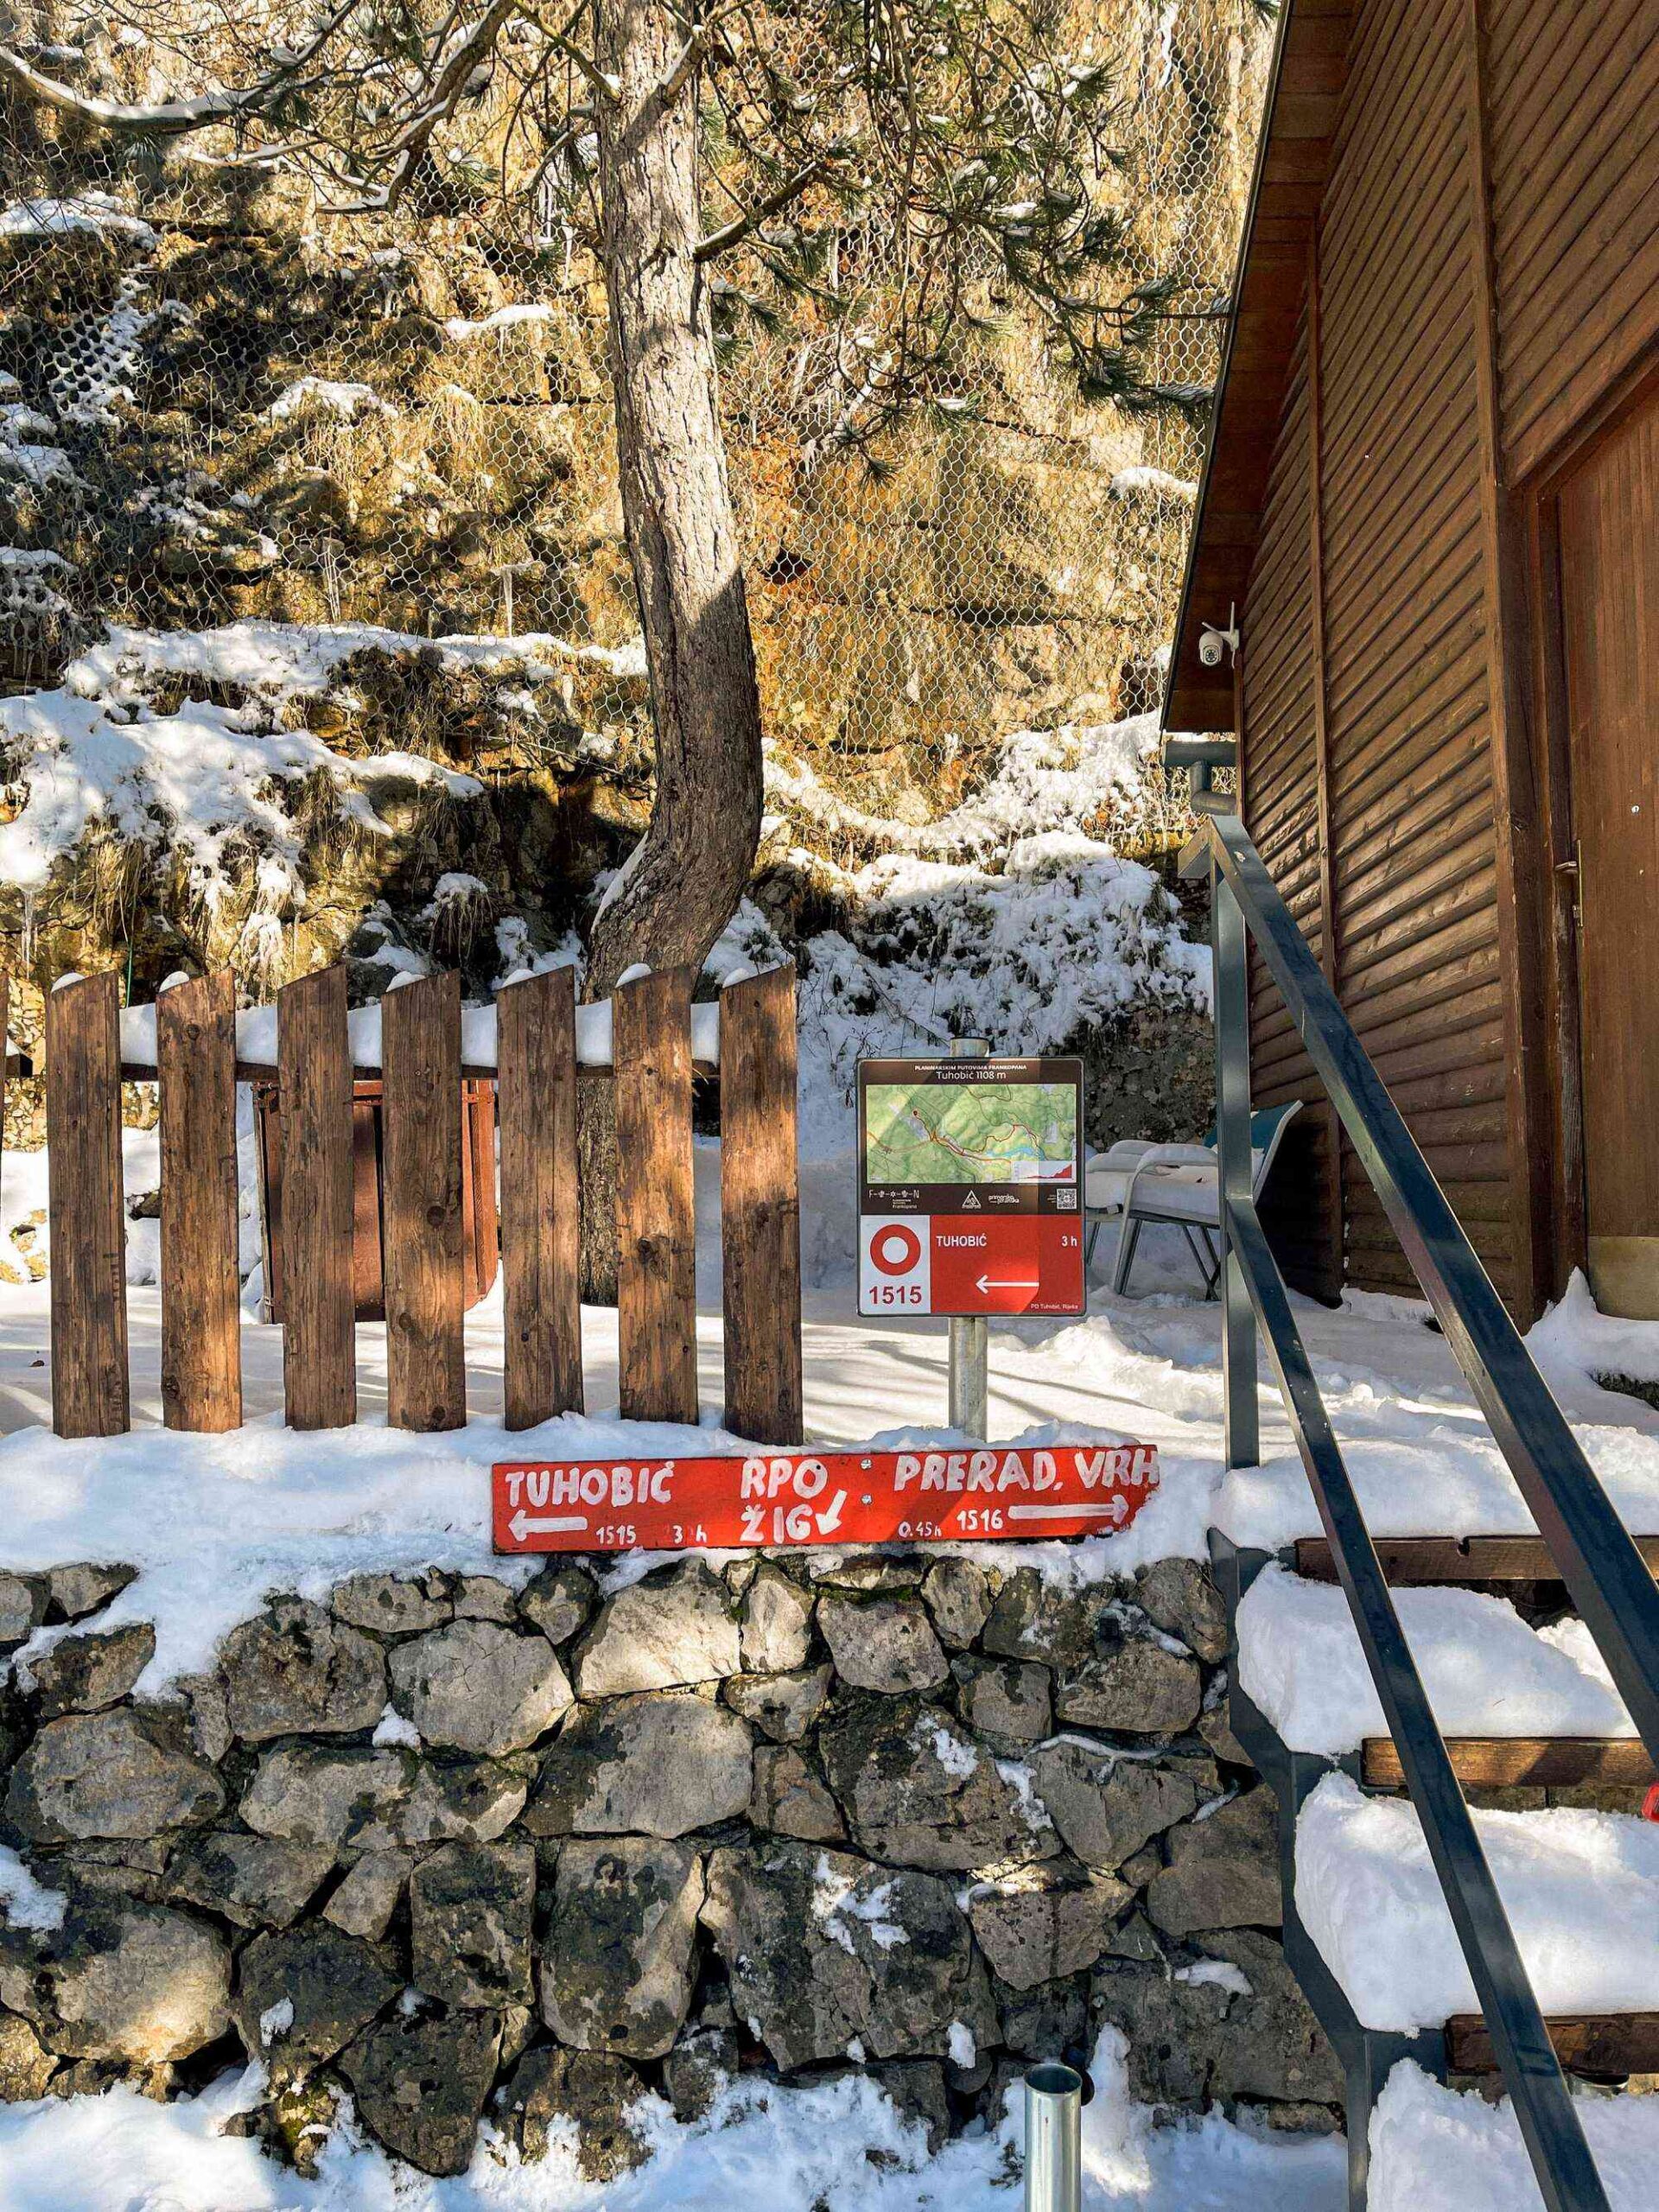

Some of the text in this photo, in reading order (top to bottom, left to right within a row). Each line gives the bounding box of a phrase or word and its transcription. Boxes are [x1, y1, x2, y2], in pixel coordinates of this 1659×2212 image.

[936, 1070, 1007, 1080] Tuhobić 1108 m
[936, 1232, 1077, 1248] TUHOBIĆ 3 h
[869, 1285, 922, 1306] 1515
[740, 1458, 829, 1500] RPO
[1074, 1444, 1160, 1489] VRH
[740, 1503, 810, 1543] ŽIG
[956, 1510, 1004, 1532] 1516
[595, 1523, 707, 1545] 1515 3 h
